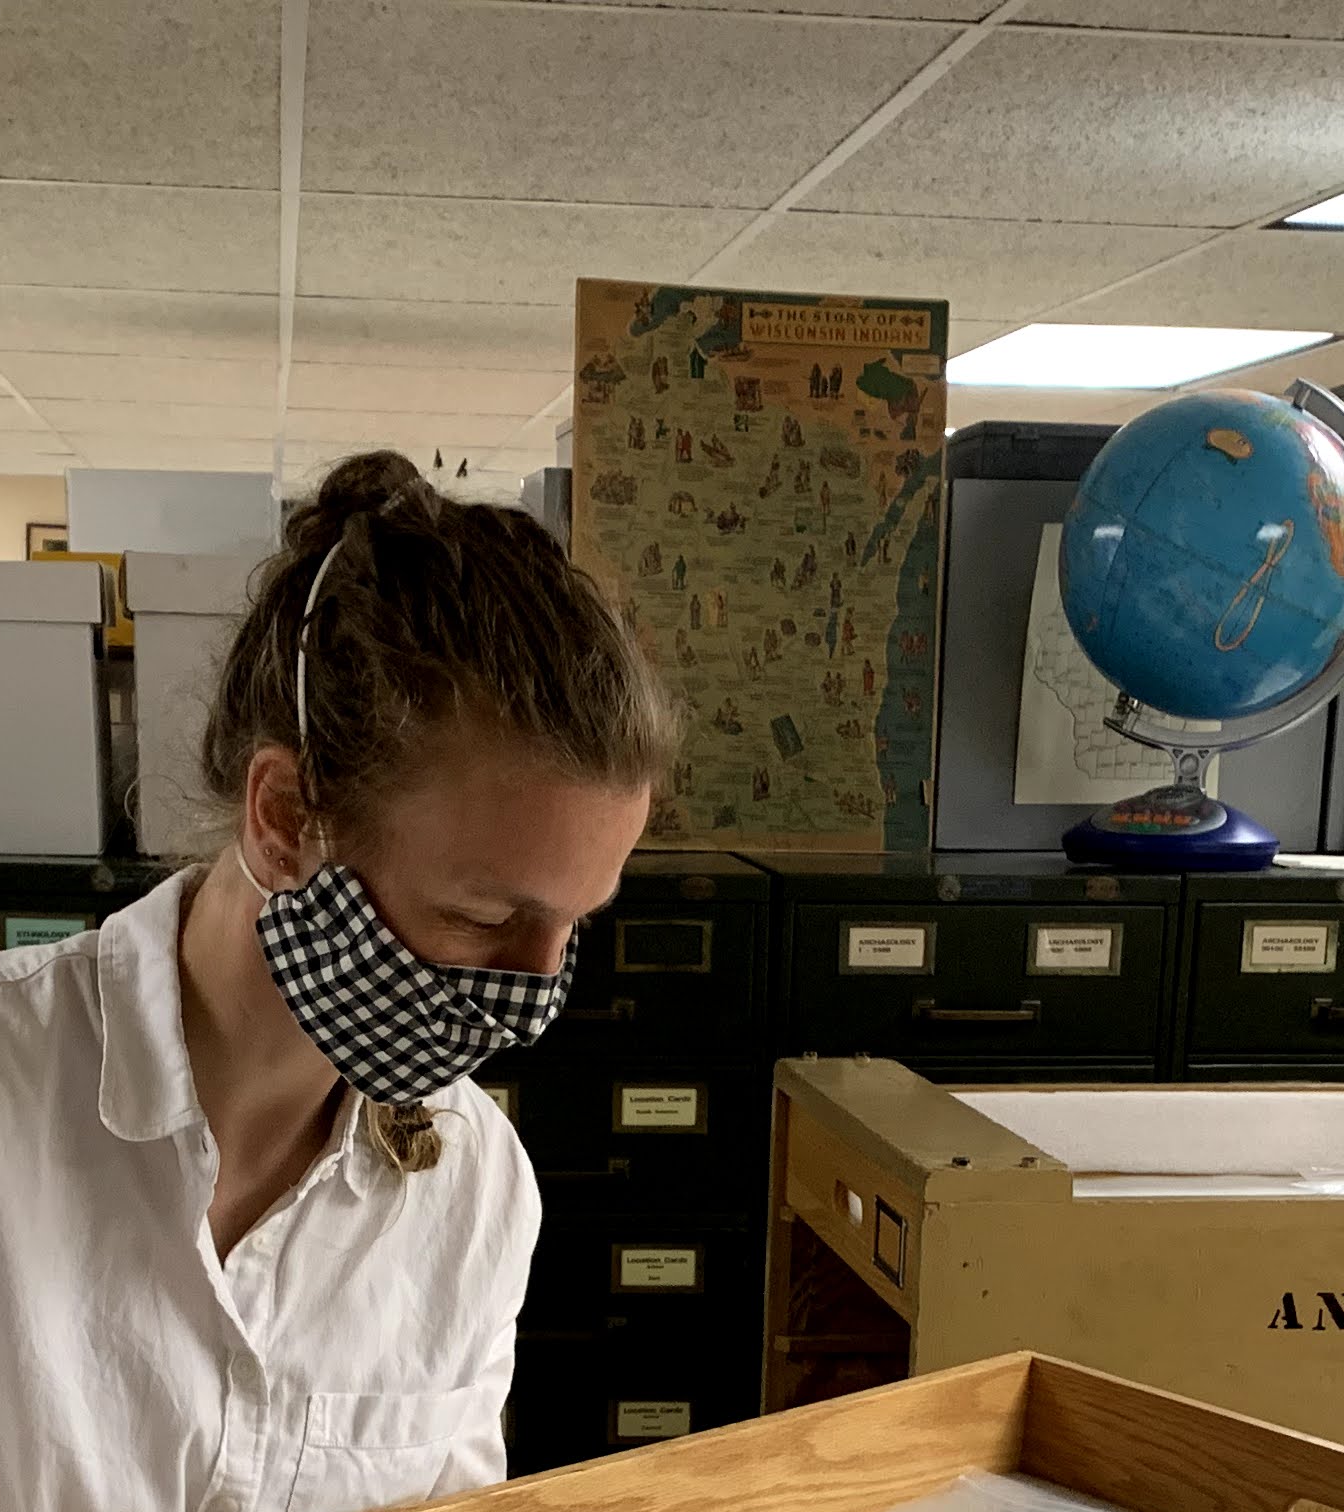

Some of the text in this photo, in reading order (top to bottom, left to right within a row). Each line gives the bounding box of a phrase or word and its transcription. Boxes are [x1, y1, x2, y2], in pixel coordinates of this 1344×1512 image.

[778, 310, 897, 326] THE STORY OF
[749, 323, 923, 343] WISCONSIN INDIANS
